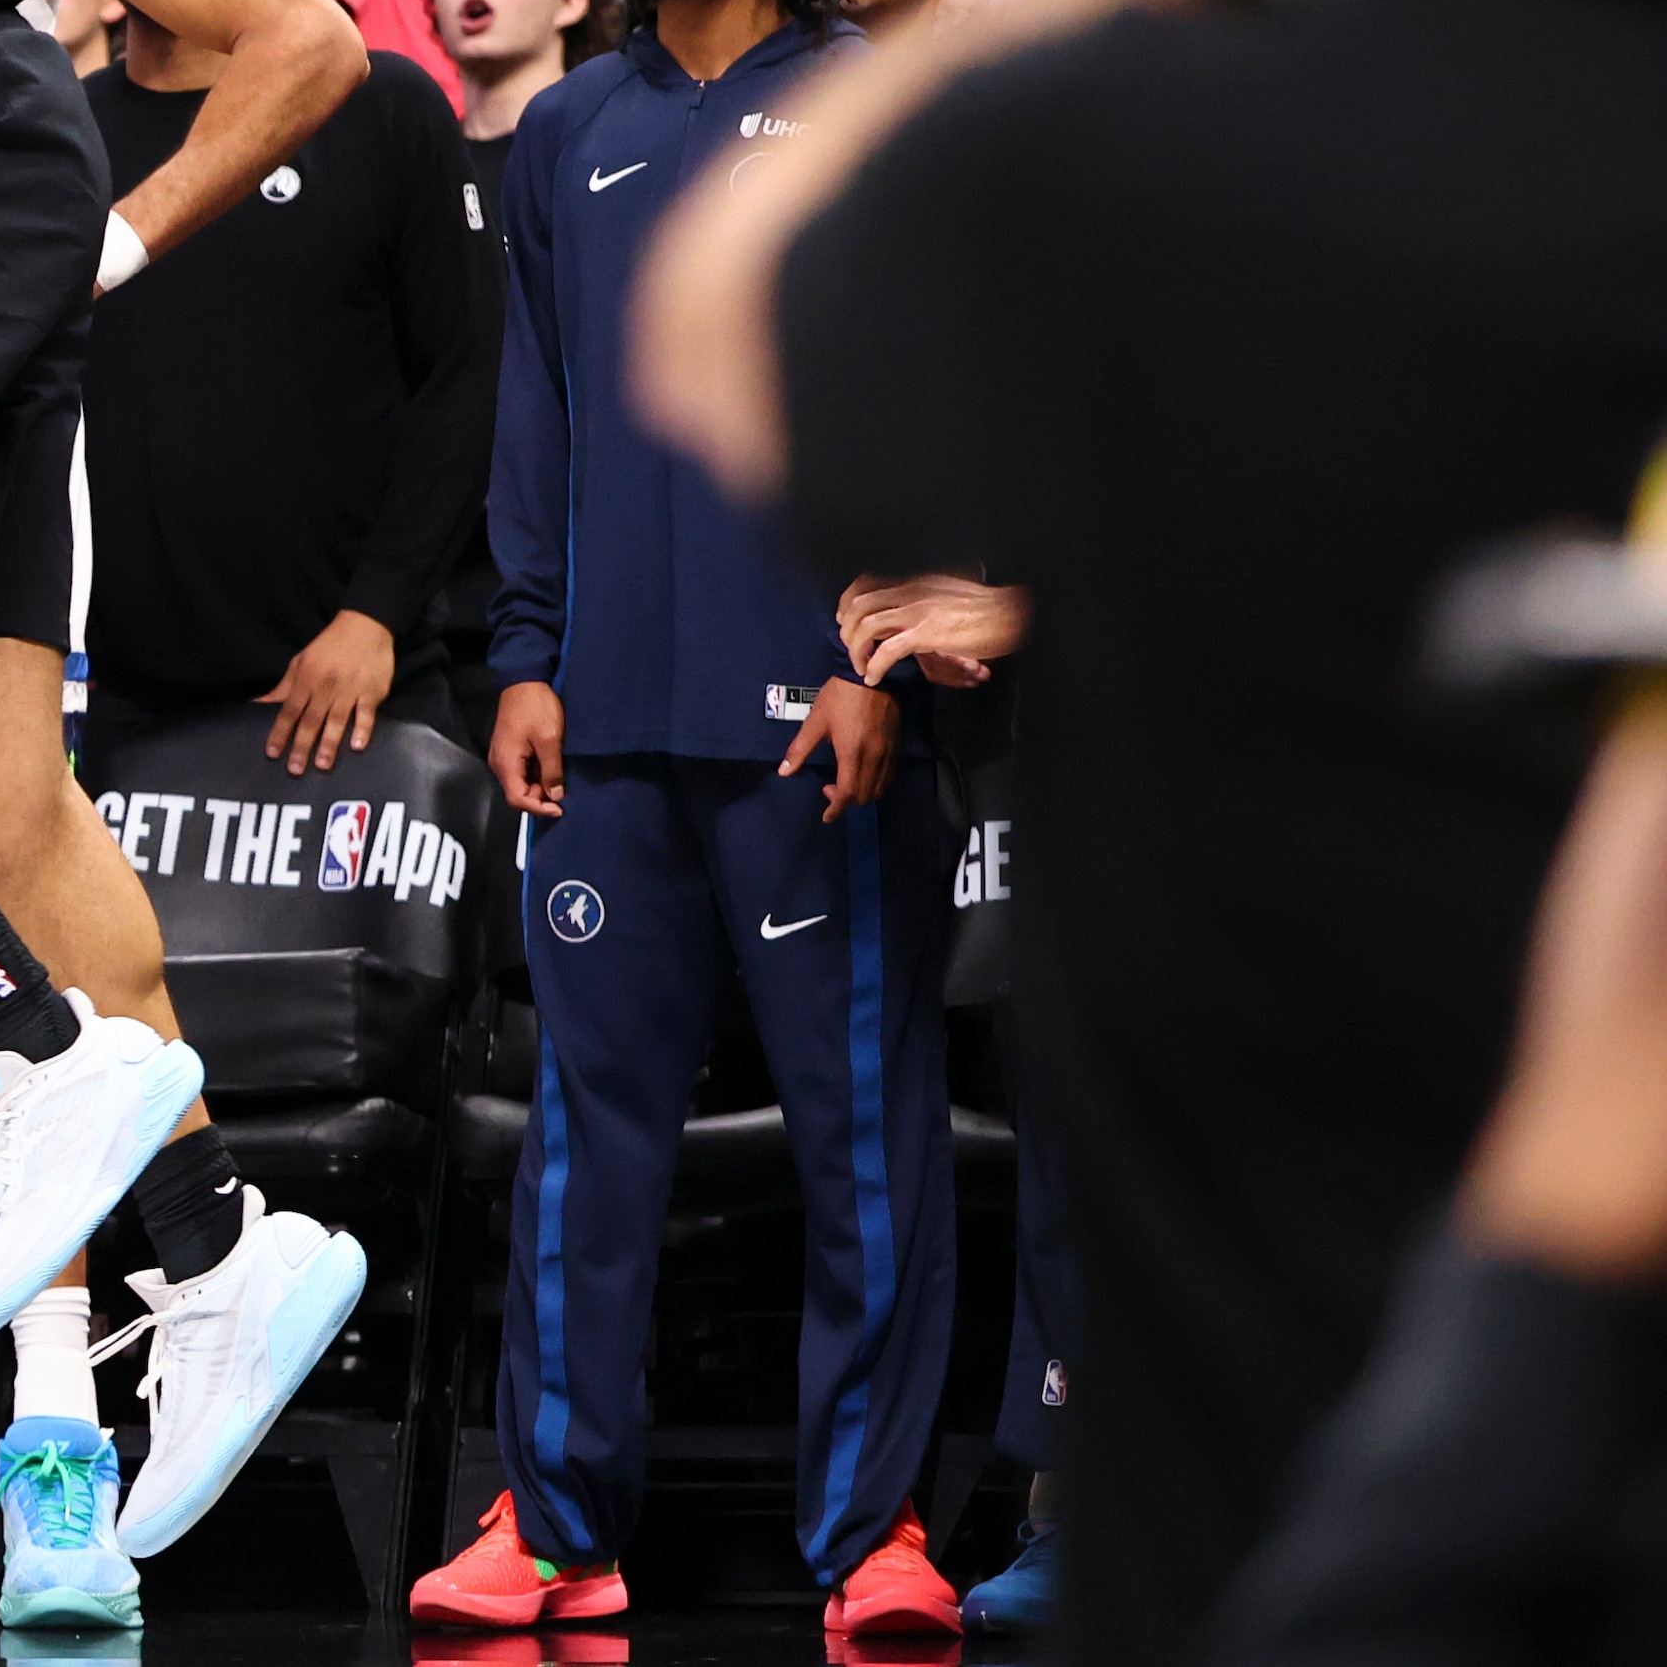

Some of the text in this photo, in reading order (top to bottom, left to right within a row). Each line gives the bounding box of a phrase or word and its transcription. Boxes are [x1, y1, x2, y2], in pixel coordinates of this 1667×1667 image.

[94, 790, 195, 876] GET
[203, 797, 312, 887] THE
[364, 800, 467, 908] App
[953, 820, 1012, 910] GE
